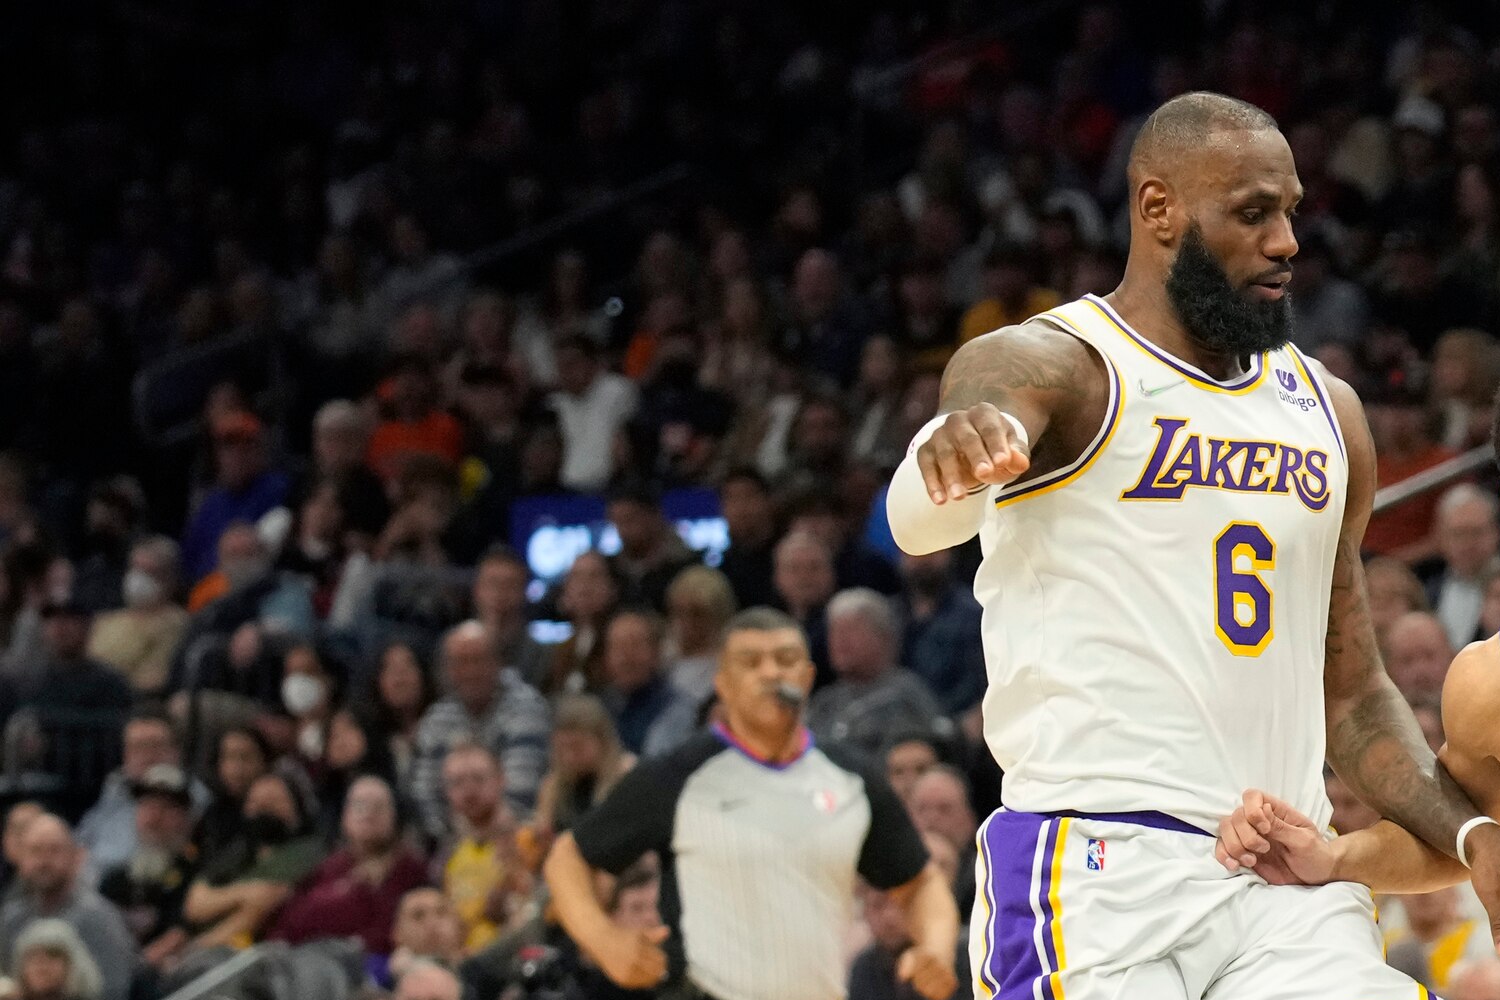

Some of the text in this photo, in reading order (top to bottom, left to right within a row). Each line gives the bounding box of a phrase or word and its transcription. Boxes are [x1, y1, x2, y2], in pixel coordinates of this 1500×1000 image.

[1278, 388, 1317, 412] bibigo
[1118, 416, 1331, 513] LAKERS
[1212, 520, 1277, 657] 6
